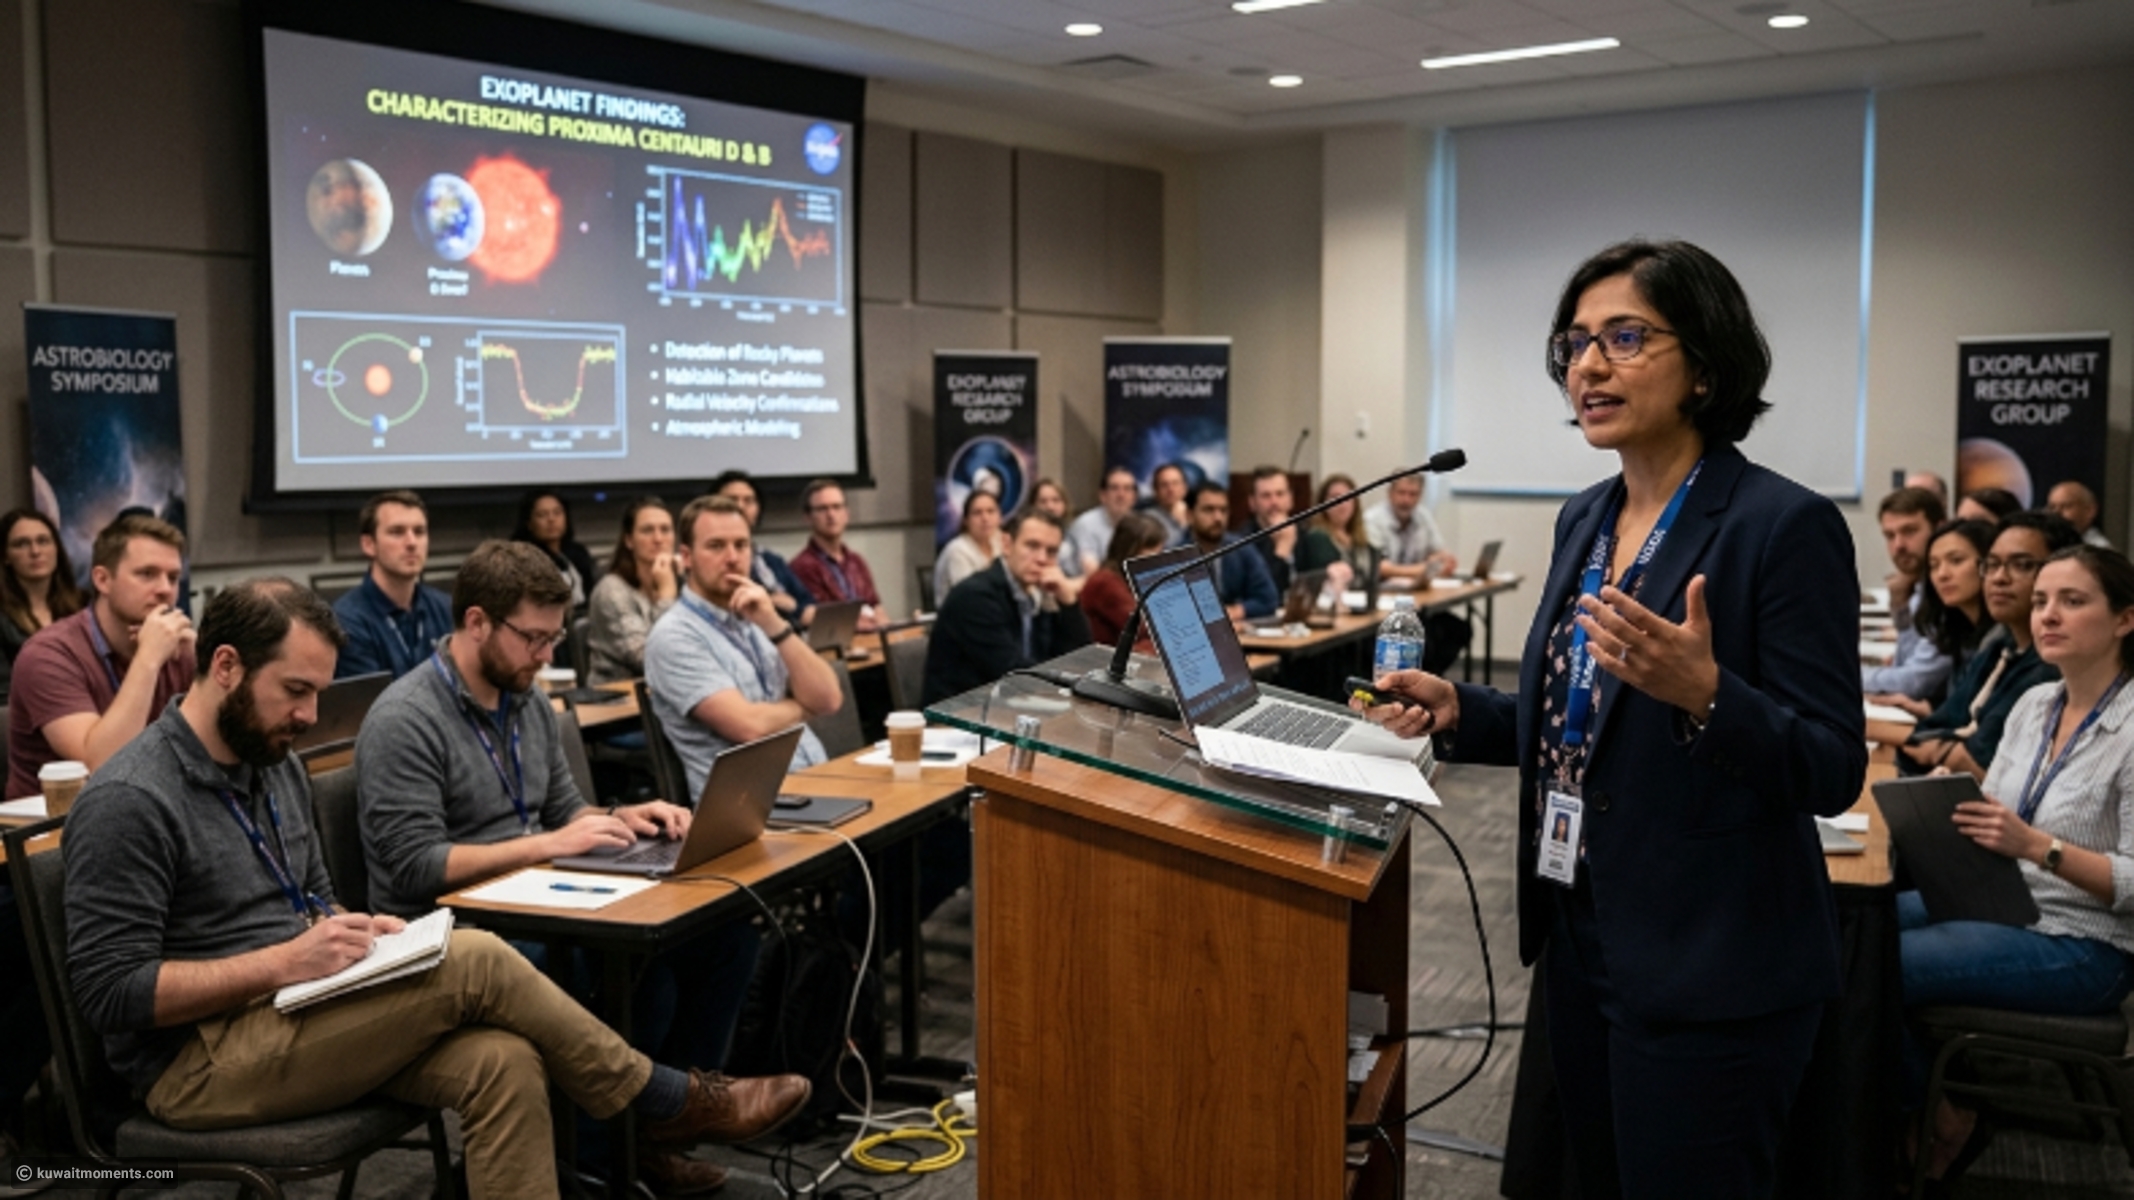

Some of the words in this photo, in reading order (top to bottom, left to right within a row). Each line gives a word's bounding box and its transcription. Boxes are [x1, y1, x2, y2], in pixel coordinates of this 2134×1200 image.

[480, 75, 592, 113] EXOPLANET
[596, 95, 686, 128] FINDINGS:
[366, 88, 545, 136] CHARACTERIZING
[549, 115, 636, 148] PROXIMA
[639, 128, 722, 160] CENTAURI
[726, 141, 739, 161] D
[758, 145, 772, 166] B
[32, 345, 174, 370] ASTROBIOLOGY
[665, 341, 726, 362] Detection
[728, 342, 742, 361] of
[1107, 364, 1227, 381] ASTROBIOLOGY
[1967, 352, 2099, 377] EXOPLANET
[51, 370, 160, 394] SYMPOSIUM
[727, 367, 759, 387] Zone
[1122, 381, 1213, 398] SYMPOSIUM
[1974, 378, 2090, 402] RESEARCH
[1990, 403, 2072, 426] GROUP
